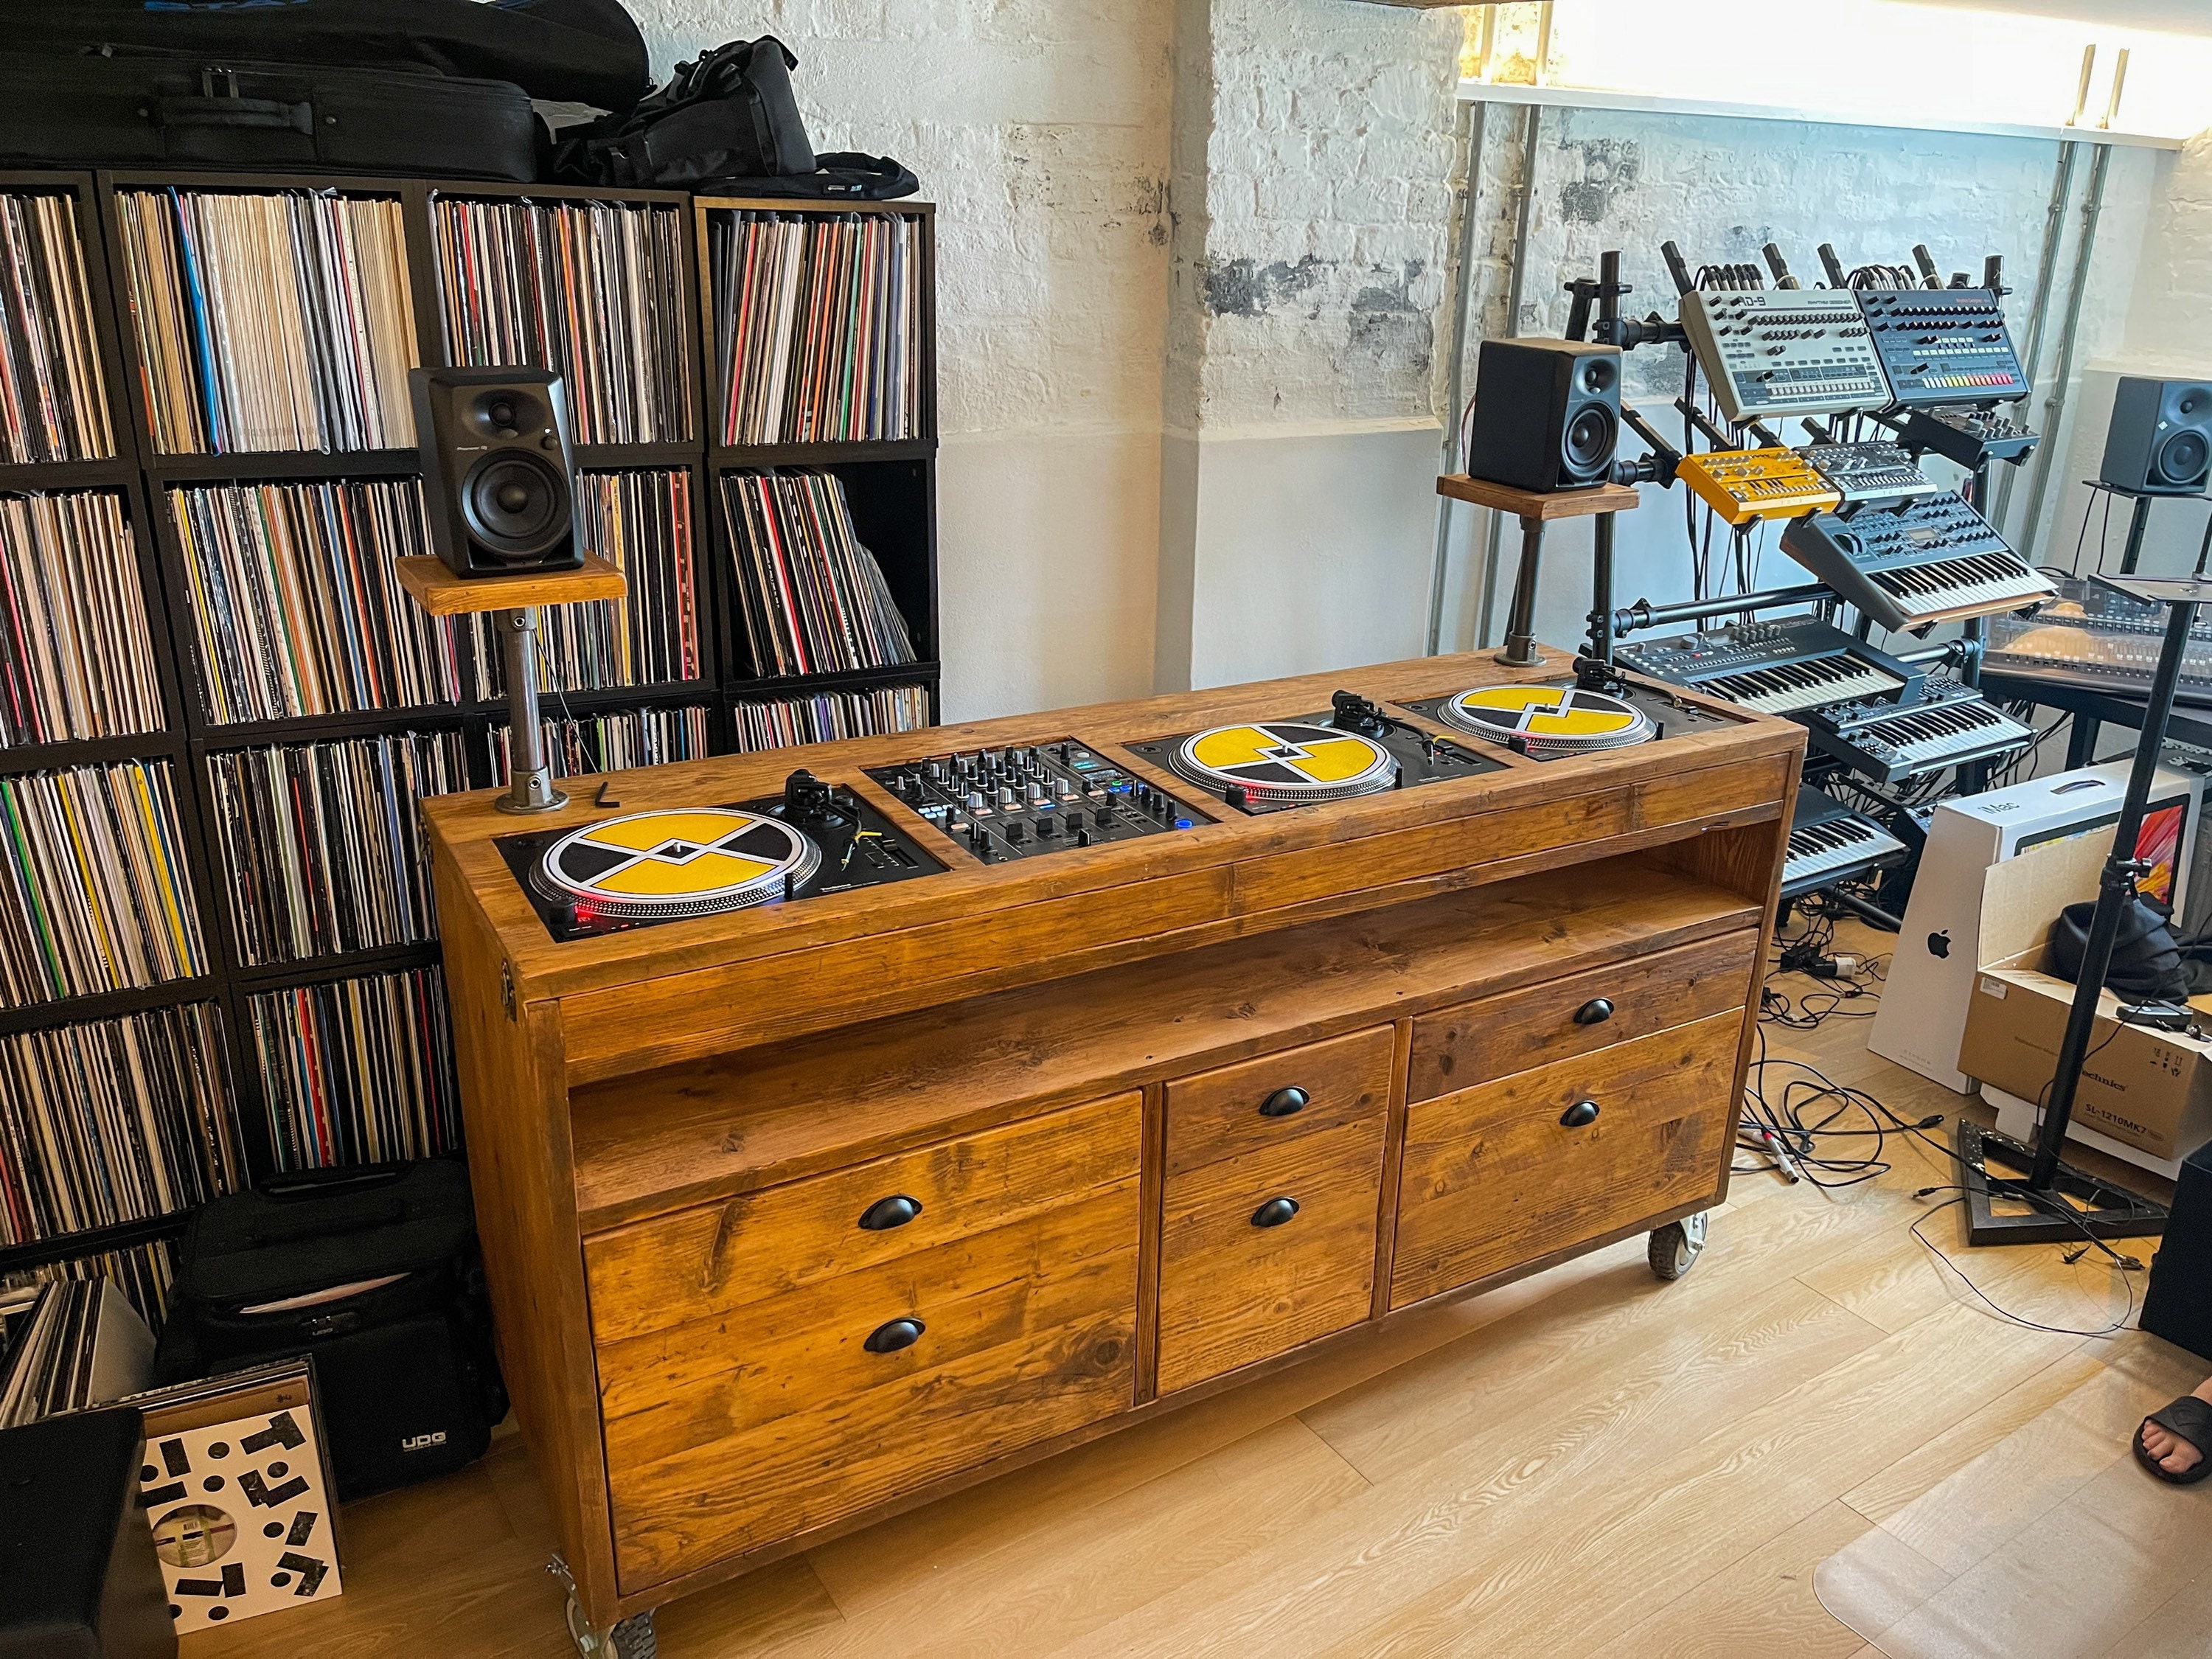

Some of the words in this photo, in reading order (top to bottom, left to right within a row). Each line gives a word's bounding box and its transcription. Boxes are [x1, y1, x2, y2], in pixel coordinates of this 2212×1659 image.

[1977, 802, 2020, 815] iMac
[2081, 1070, 2126, 1092] echnics
[2085, 1103, 2147, 1134] SL-1210MK7
[402, 1431, 446, 1449] UDG
